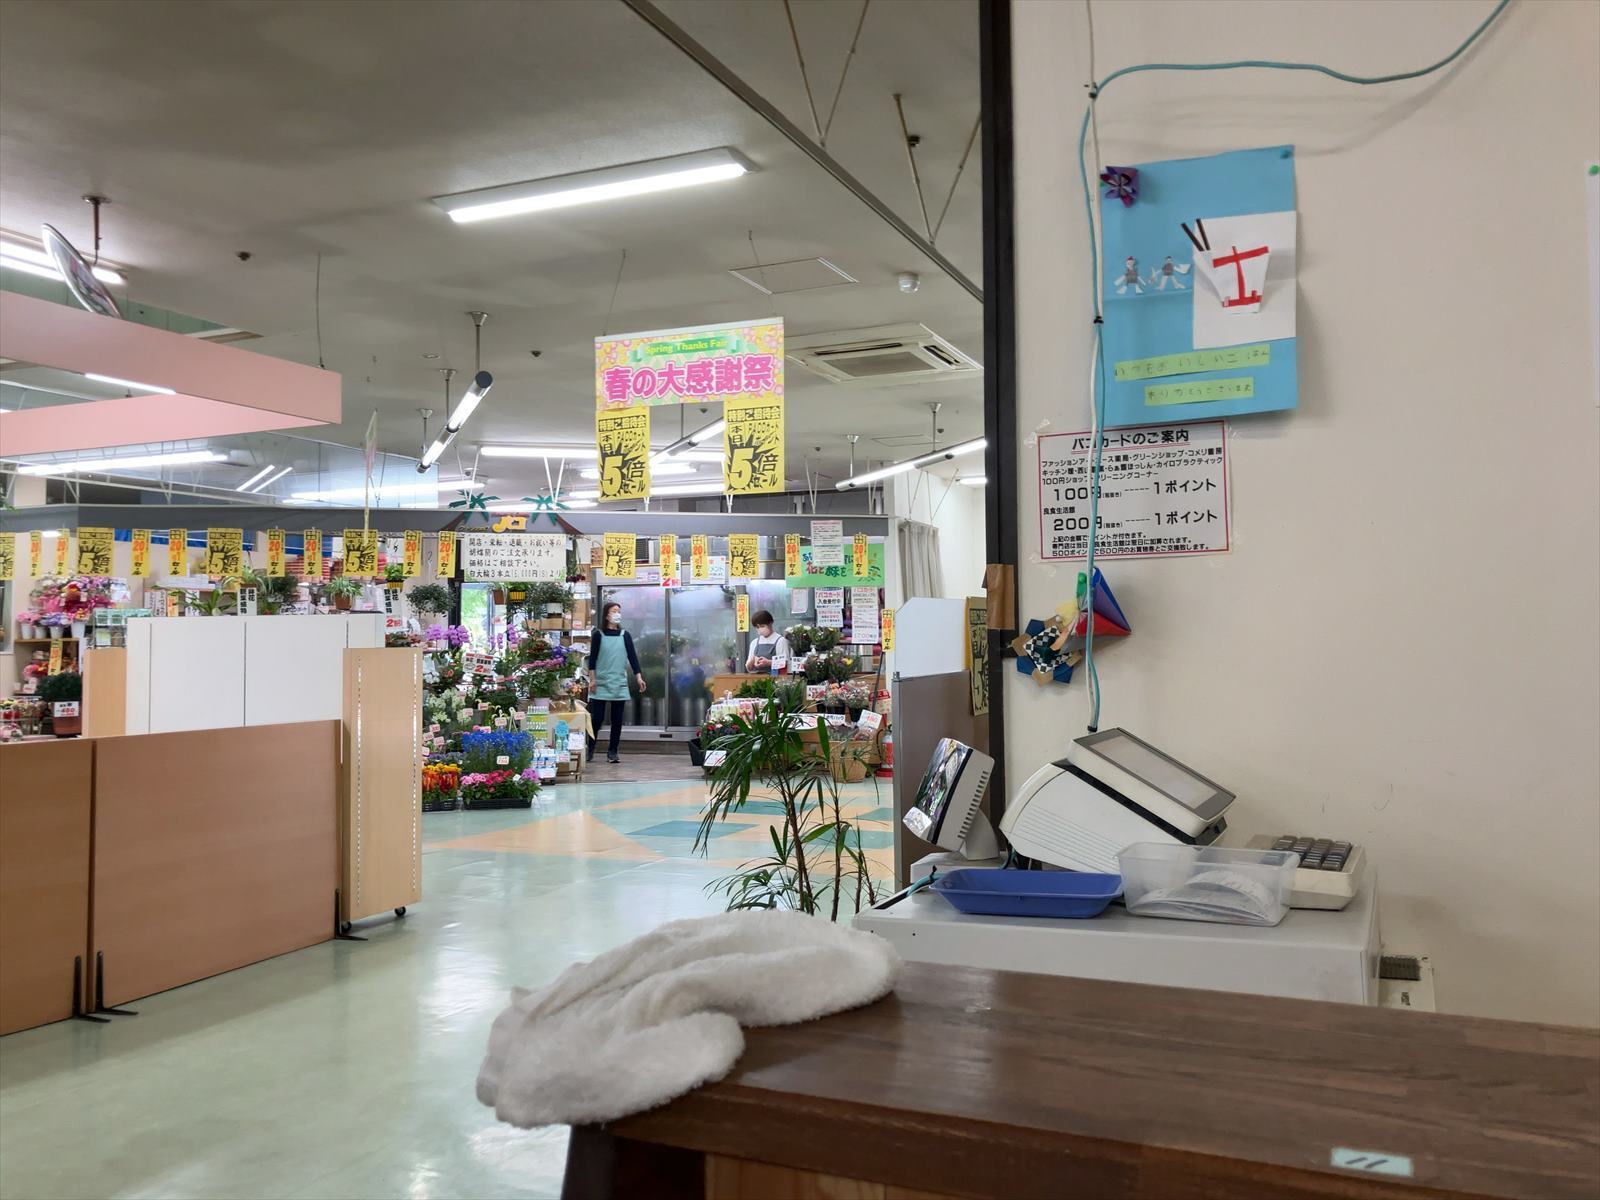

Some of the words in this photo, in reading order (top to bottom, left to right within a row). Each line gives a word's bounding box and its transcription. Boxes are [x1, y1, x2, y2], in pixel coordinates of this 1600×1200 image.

[677, 341, 708, 352] Thanks
[604, 356, 773, 401] 春の大感謝祭
